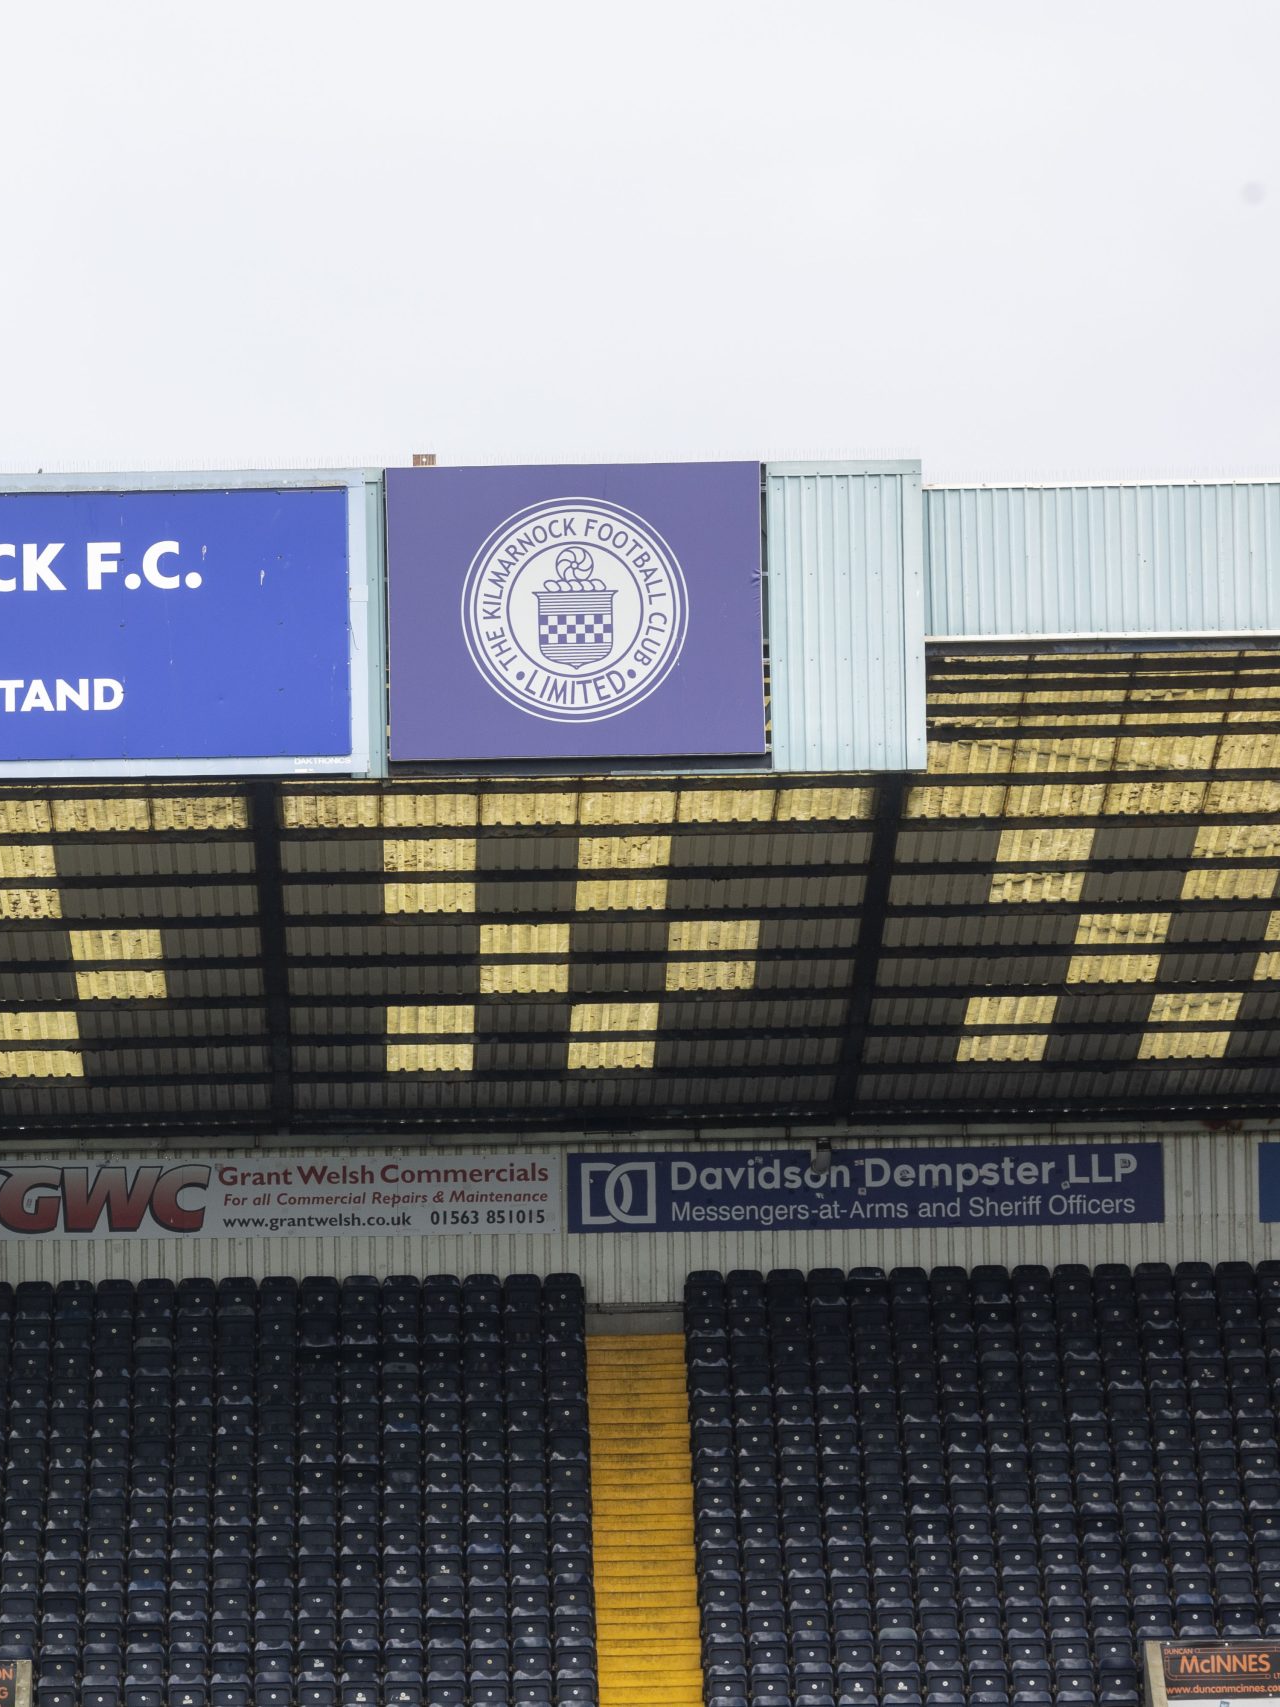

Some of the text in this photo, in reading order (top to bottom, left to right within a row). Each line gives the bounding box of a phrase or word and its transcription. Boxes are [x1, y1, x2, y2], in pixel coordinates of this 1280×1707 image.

[86, 540, 203, 591] F.C.
[482, 517, 668, 672] THE KILMARNOCK FOOTBALL CLUB
[524, 669, 627, 704] LIMITED
[219, 1162, 548, 1186] Grant Welsh Commercials
[671, 1153, 1138, 1192] Davidson Dempster LLP
[223, 1189, 548, 1207] For all Commercial Repairs & Maintenance
[671, 1194, 1136, 1225] Messengers-at-Arms and Sheriff Officers
[223, 1209, 546, 1231] www.grantwelsh.co.uk 01563 851015
[1180, 1653, 1271, 1674] McINNES
